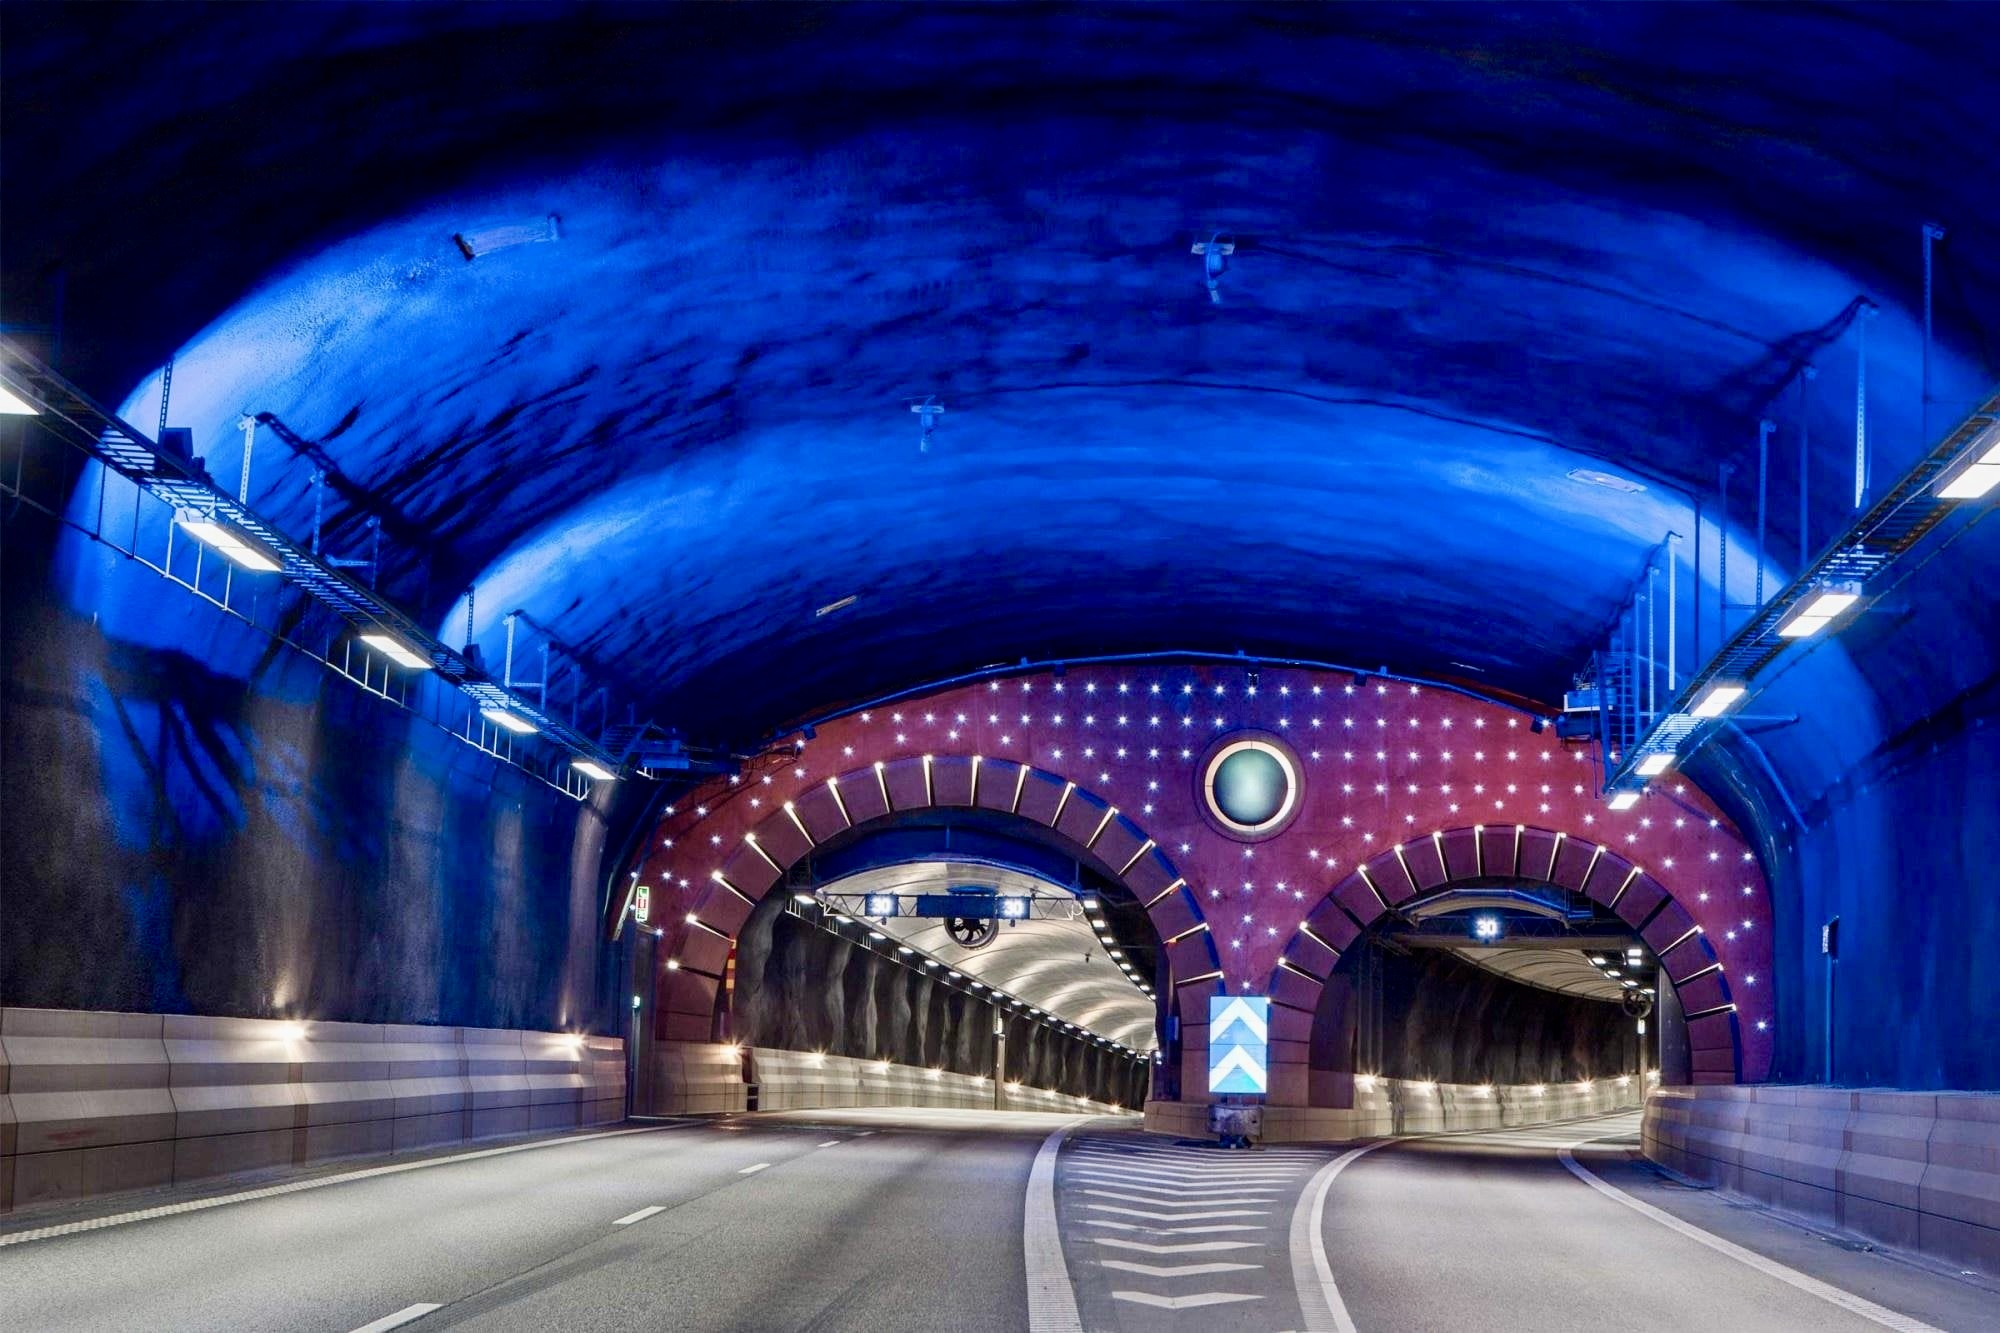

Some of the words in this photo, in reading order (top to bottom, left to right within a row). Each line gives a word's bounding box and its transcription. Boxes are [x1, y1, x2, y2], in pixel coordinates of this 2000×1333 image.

[871, 898, 891, 914] 30
[1004, 900, 1024, 917] 30
[1477, 919, 1497, 936] 30
